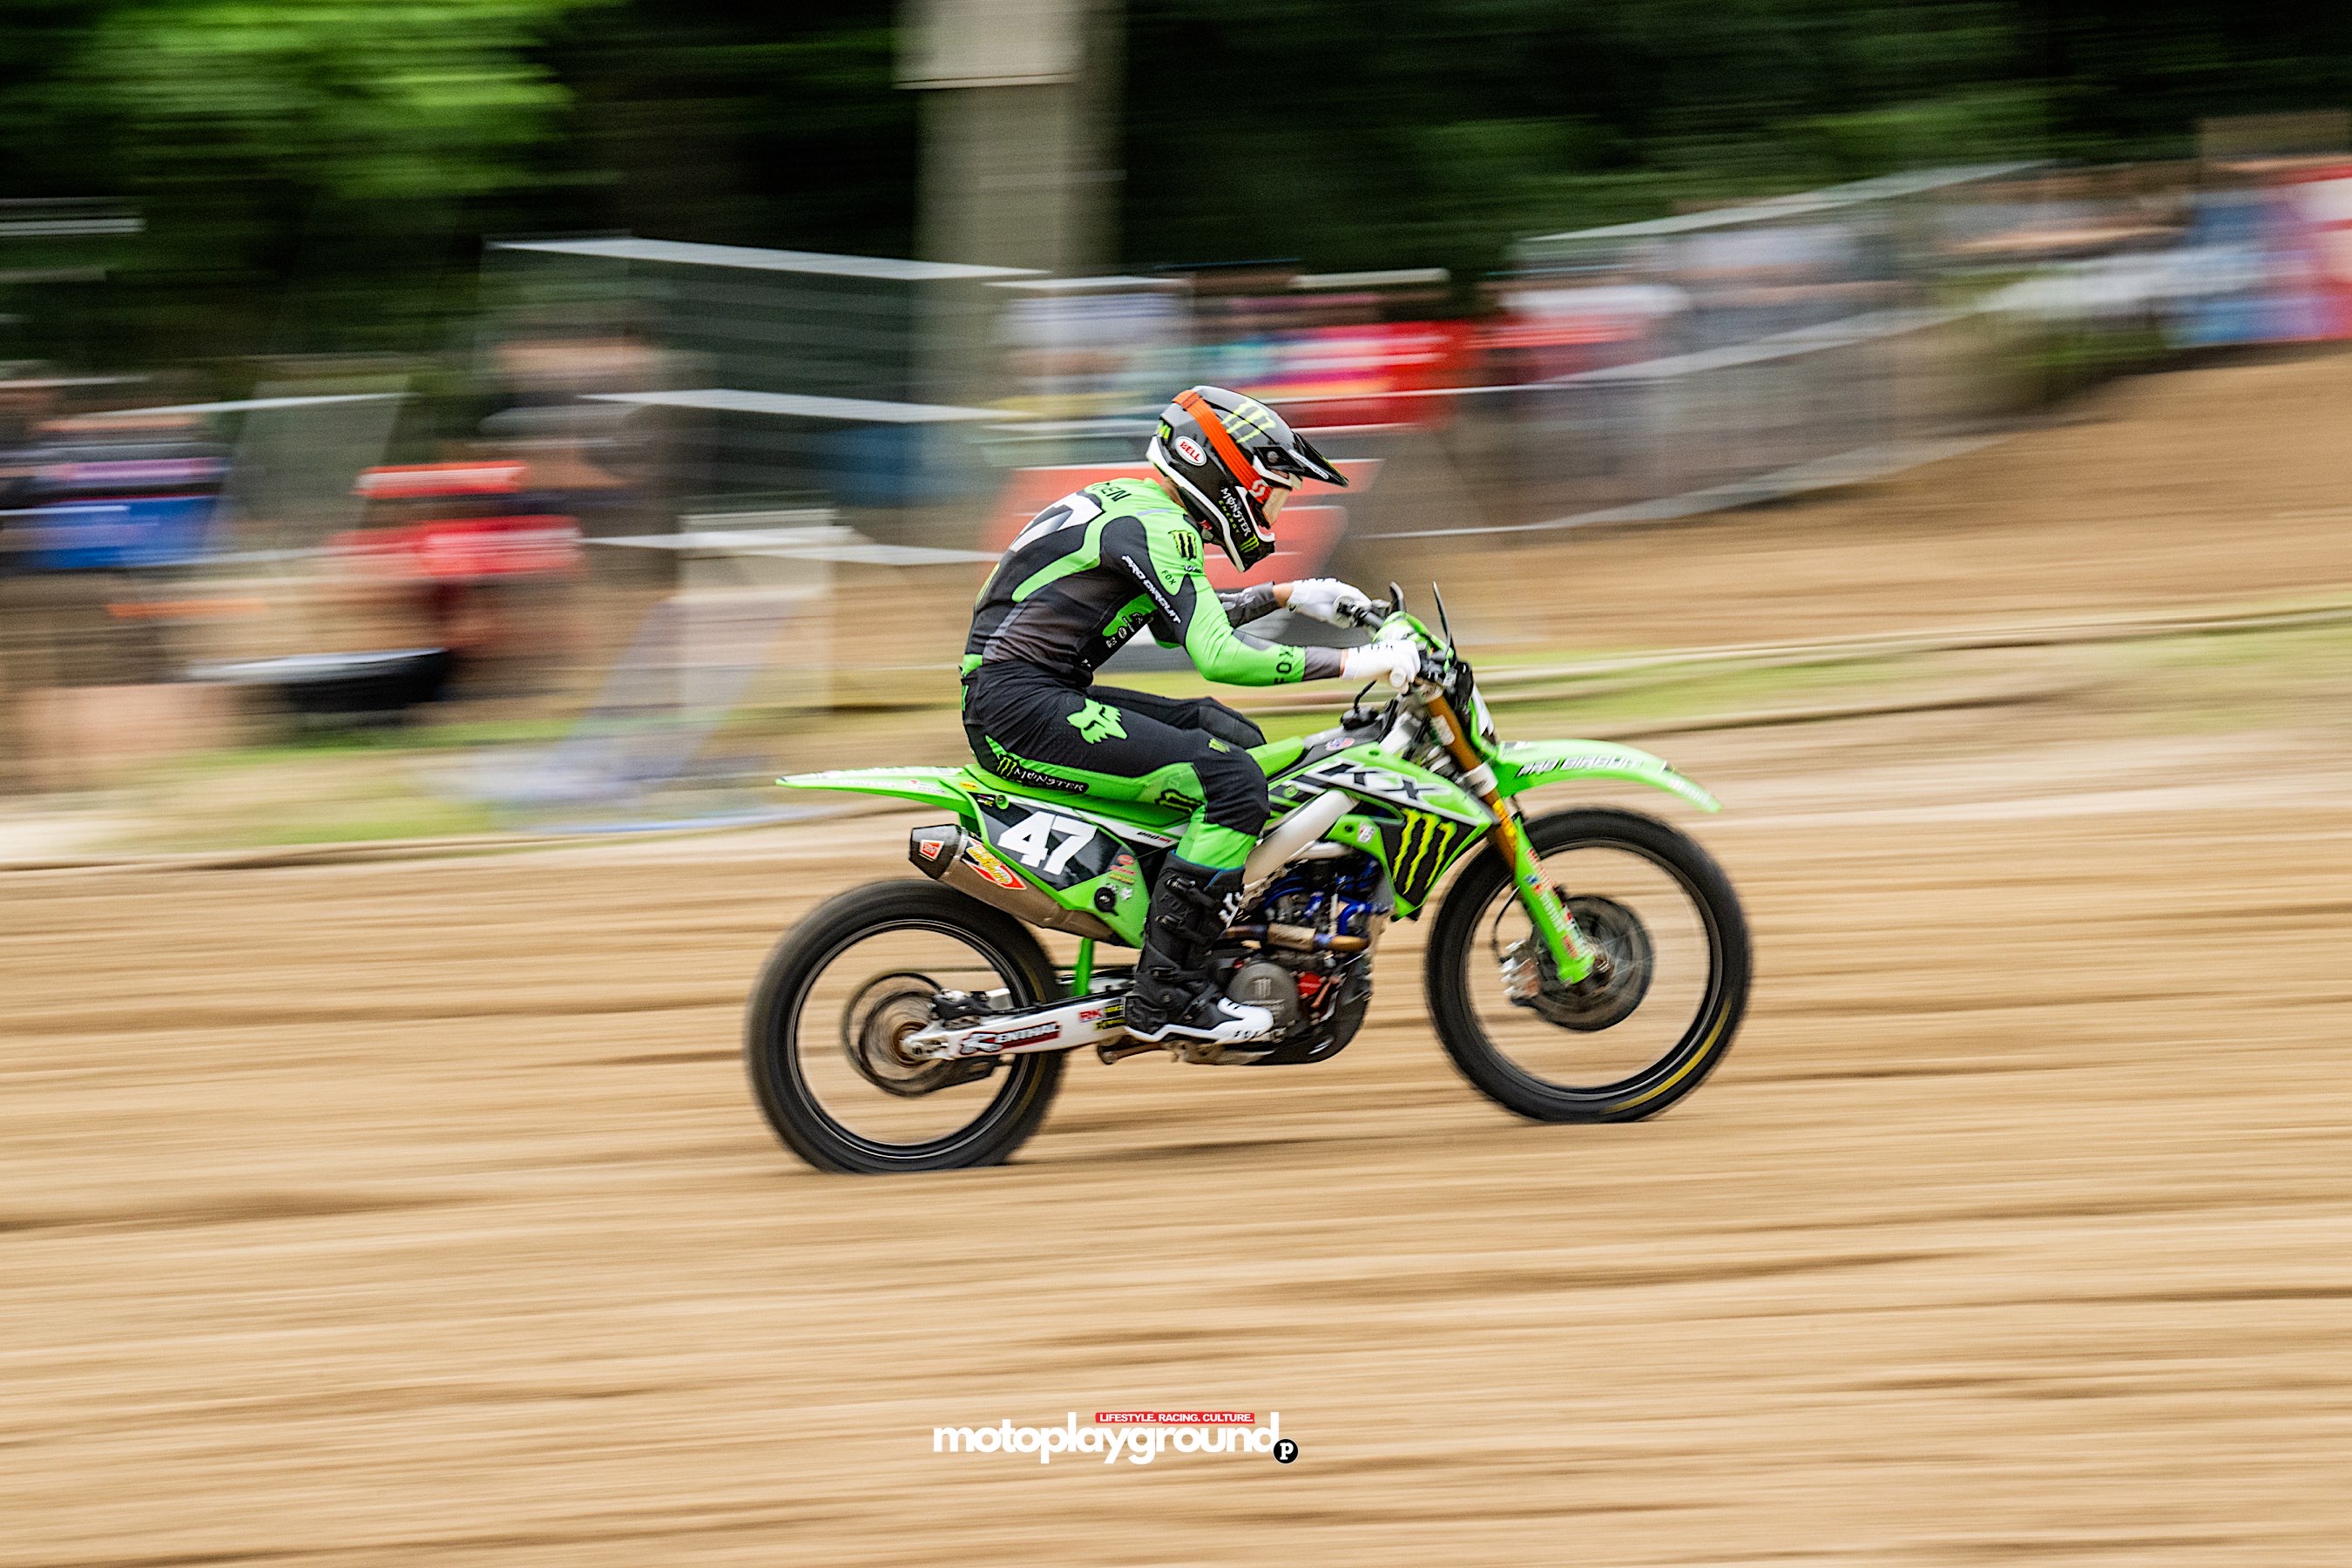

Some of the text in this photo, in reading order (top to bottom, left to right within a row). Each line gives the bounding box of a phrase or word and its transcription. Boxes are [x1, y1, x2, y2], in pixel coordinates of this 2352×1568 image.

[1179, 440, 1200, 463] BELL
[1218, 499, 1240, 535] ENERGY
[1161, 569, 1177, 586] FOX
[1143, 578, 1182, 625] CIRCUIT
[997, 810, 1098, 875] 47
